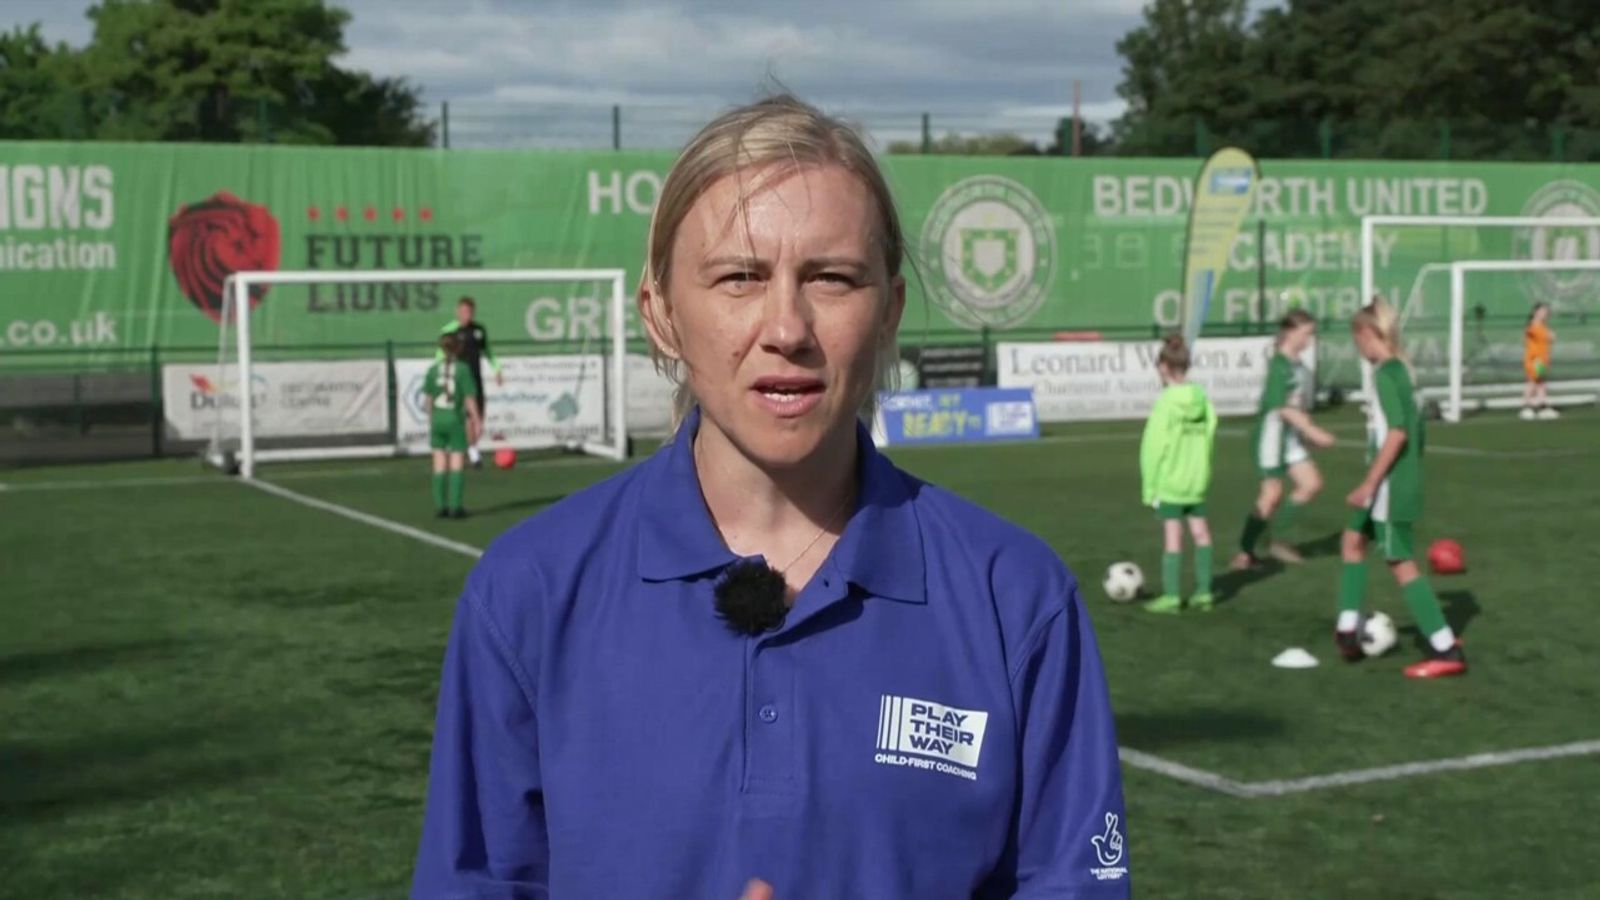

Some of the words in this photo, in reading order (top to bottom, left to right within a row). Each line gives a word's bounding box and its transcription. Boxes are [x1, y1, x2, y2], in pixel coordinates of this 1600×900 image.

[588, 169, 658, 215] HO
[1092, 174, 1336, 218] BEDRTH
[1347, 178, 1487, 216] UNITED
[305, 234, 484, 268] FUTURE
[1229, 230, 1398, 271] CADEMY
[307, 281, 441, 312] LIONS
[1153, 290, 1185, 327] O
[1223, 287, 1425, 324] FOOTBLL
[524, 296, 637, 342] GRE
[1010, 345, 1127, 376] Leonard
[910, 702, 969, 728] PLAY
[908, 734, 954, 756] WAY
[909, 718, 975, 746] THEIR
[874, 752, 936, 771] CHILD-FIRST
[935, 761, 978, 781] COACHING
